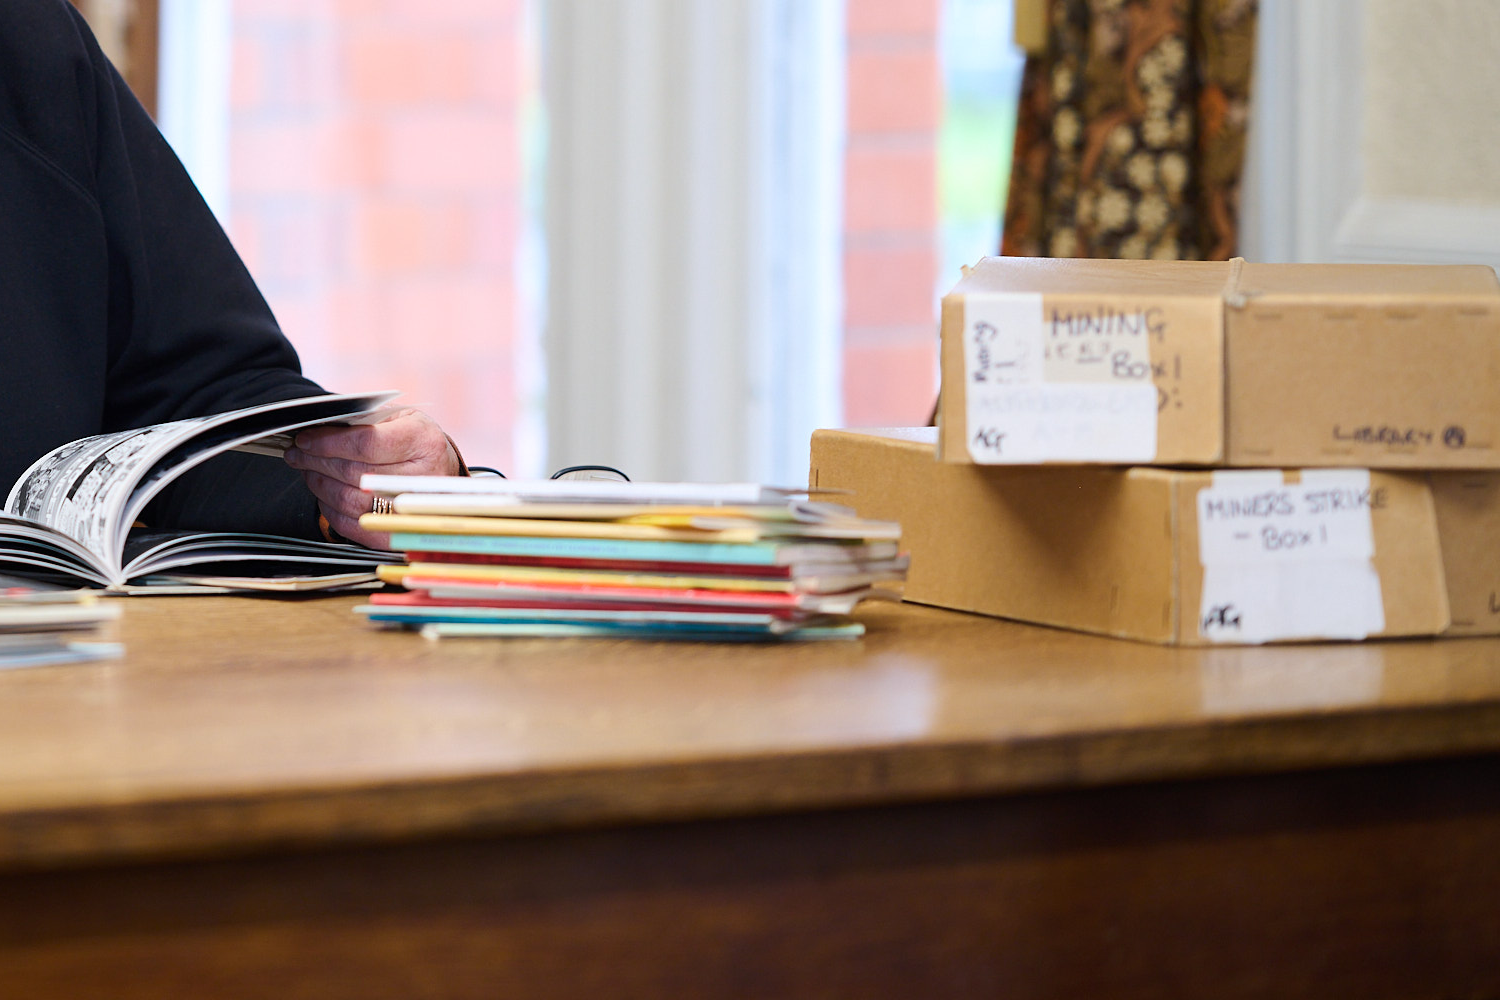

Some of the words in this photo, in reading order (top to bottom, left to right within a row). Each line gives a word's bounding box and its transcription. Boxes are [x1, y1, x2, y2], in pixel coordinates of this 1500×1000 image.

[1051, 306, 1168, 342] MINING
[1206, 492, 1294, 519] MINERS
[1305, 487, 1389, 515] STRIKE
